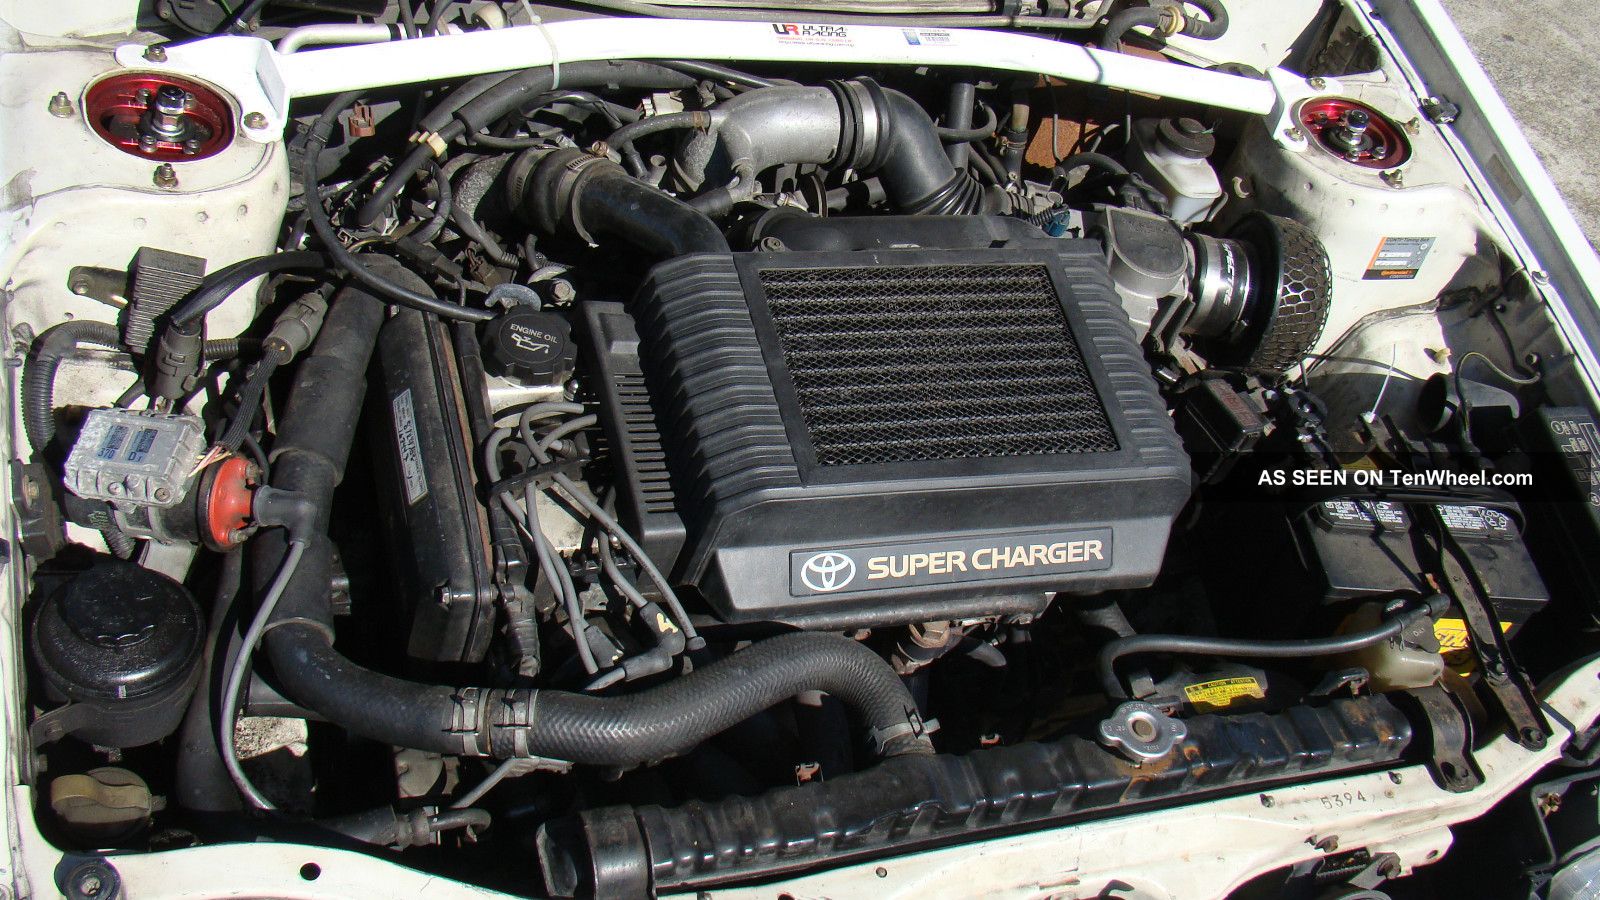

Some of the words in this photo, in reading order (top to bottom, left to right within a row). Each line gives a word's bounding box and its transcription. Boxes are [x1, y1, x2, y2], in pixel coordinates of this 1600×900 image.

[510, 323, 543, 338] ENGINE
[544, 334, 558, 344] OIL
[867, 550, 968, 580] SUPER
[971, 539, 1104, 571] CHARGER
